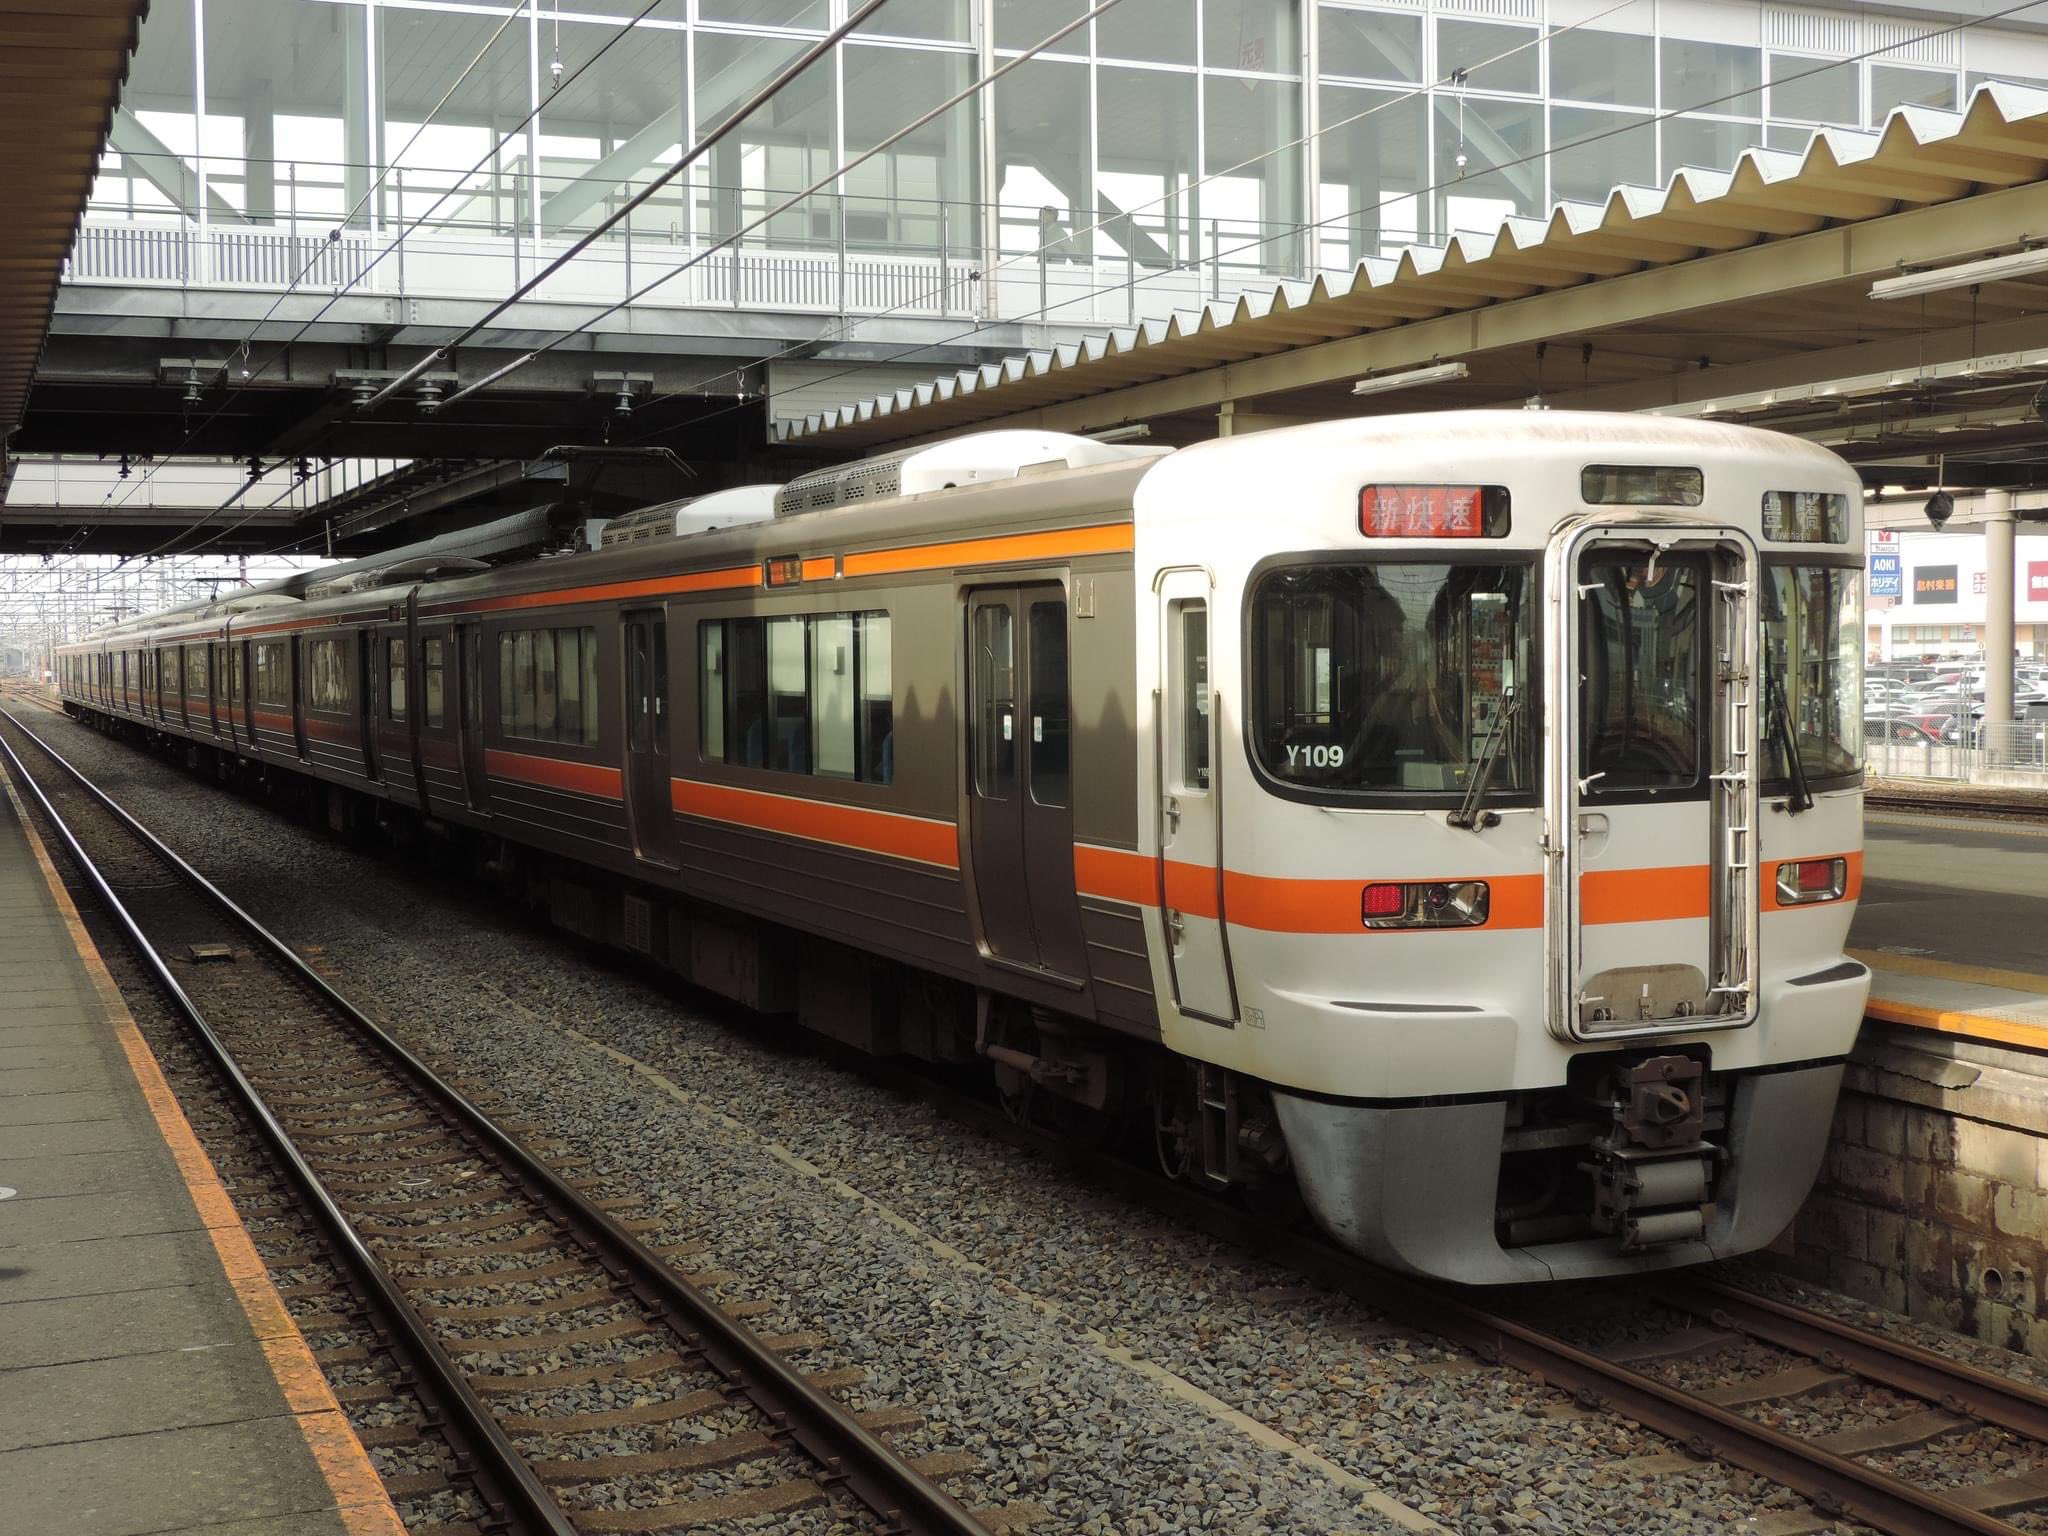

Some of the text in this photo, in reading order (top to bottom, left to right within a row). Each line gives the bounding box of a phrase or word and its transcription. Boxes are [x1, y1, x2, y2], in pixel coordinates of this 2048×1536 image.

[1370, 496, 1474, 530] 新快速
[1873, 559, 1896, 571] AOKI
[1871, 576, 1899, 588] ホリデイ
[1285, 744, 1344, 768] Y109
